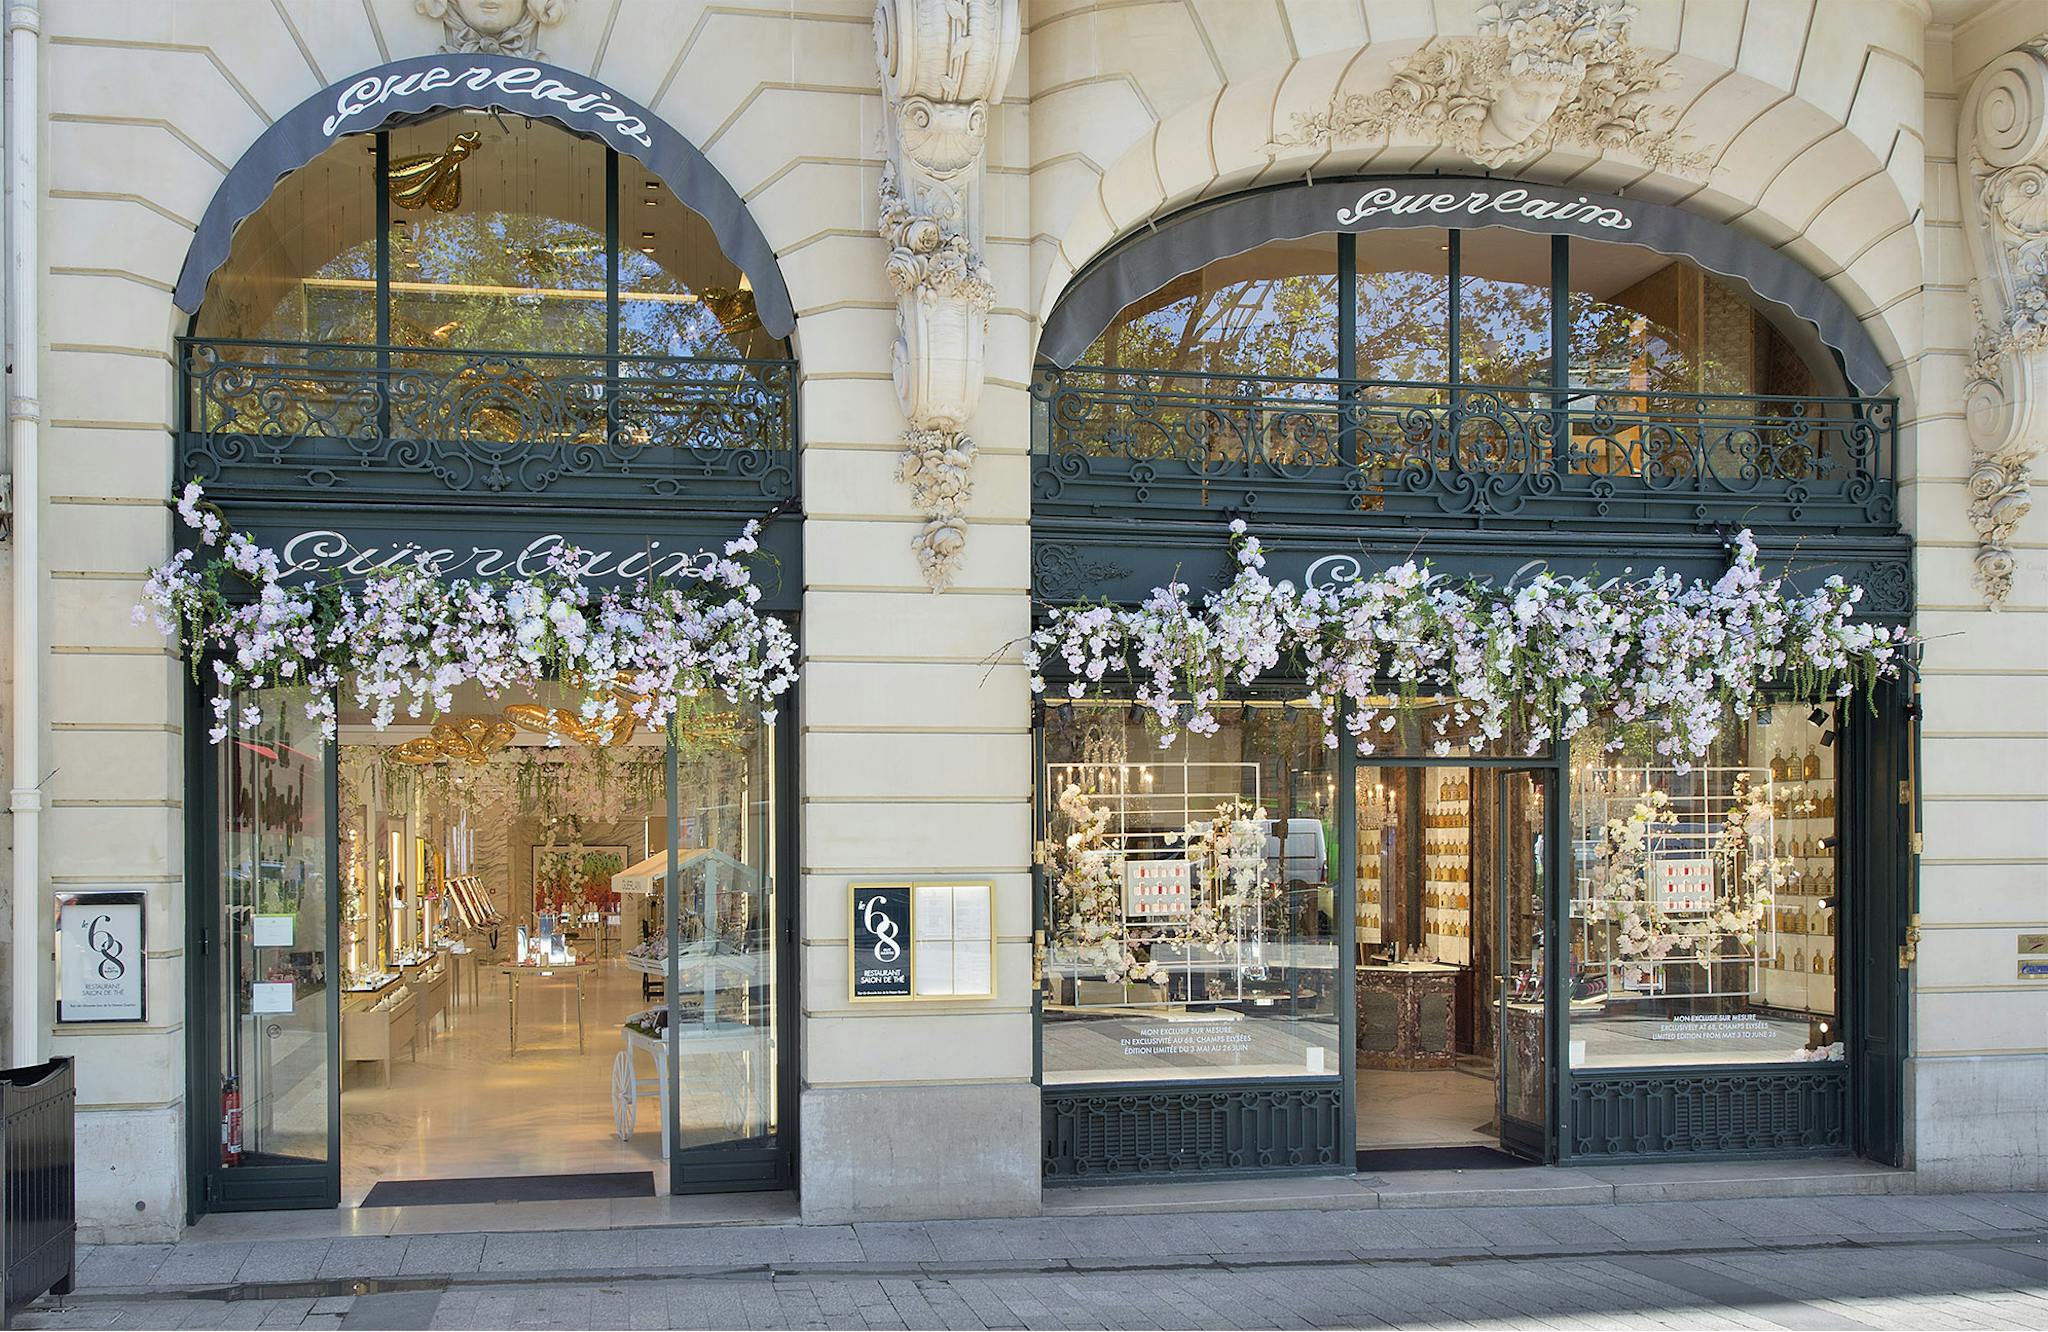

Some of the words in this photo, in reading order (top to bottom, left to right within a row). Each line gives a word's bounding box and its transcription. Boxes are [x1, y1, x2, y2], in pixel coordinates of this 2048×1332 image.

[323, 67, 652, 147] Guerlain
[1337, 187, 1633, 229] Guerlain
[864, 895, 901, 963] 68
[88, 914, 125, 981] 68
[864, 969, 901, 977] RESTAURANT
[860, 976, 882, 984] SALON
[883, 976, 892, 984] DE
[893, 974, 905, 983] THÉ
[82, 989, 103, 997] SALON
[1691, 1014, 1718, 1022] EXCLUSIF
[1732, 1013, 1757, 1021] MESURE
[1140, 1028, 1159, 1036] MON
[1160, 1027, 1189, 1036] EXCLUSIF
[1205, 1026, 1232, 1034] MESURE
[1660, 1023, 1698, 1031] EXCLUSIVELY
[1699, 1023, 1708, 1031] AT
[1718, 1022, 1745, 1030] CHAMPS
[1120, 1038, 1131, 1046] EN
[1131, 1036, 1172, 1046] EXCLUSIVITÉ
[1173, 1036, 1183, 1044] AU
[1197, 1035, 1225, 1043] CHAMPS
[1677, 1032, 1702, 1040] EDITION
[1124, 1045, 1152, 1055] ÉDITION
[1153, 1044, 1178, 1054] LIMITÉE
[1190, 1045, 1195, 1053] 3
[1195, 1045, 1210, 1053] MAI
[1210, 1044, 1221, 1052] AU
[1231, 1043, 1248, 1052] JUIN
